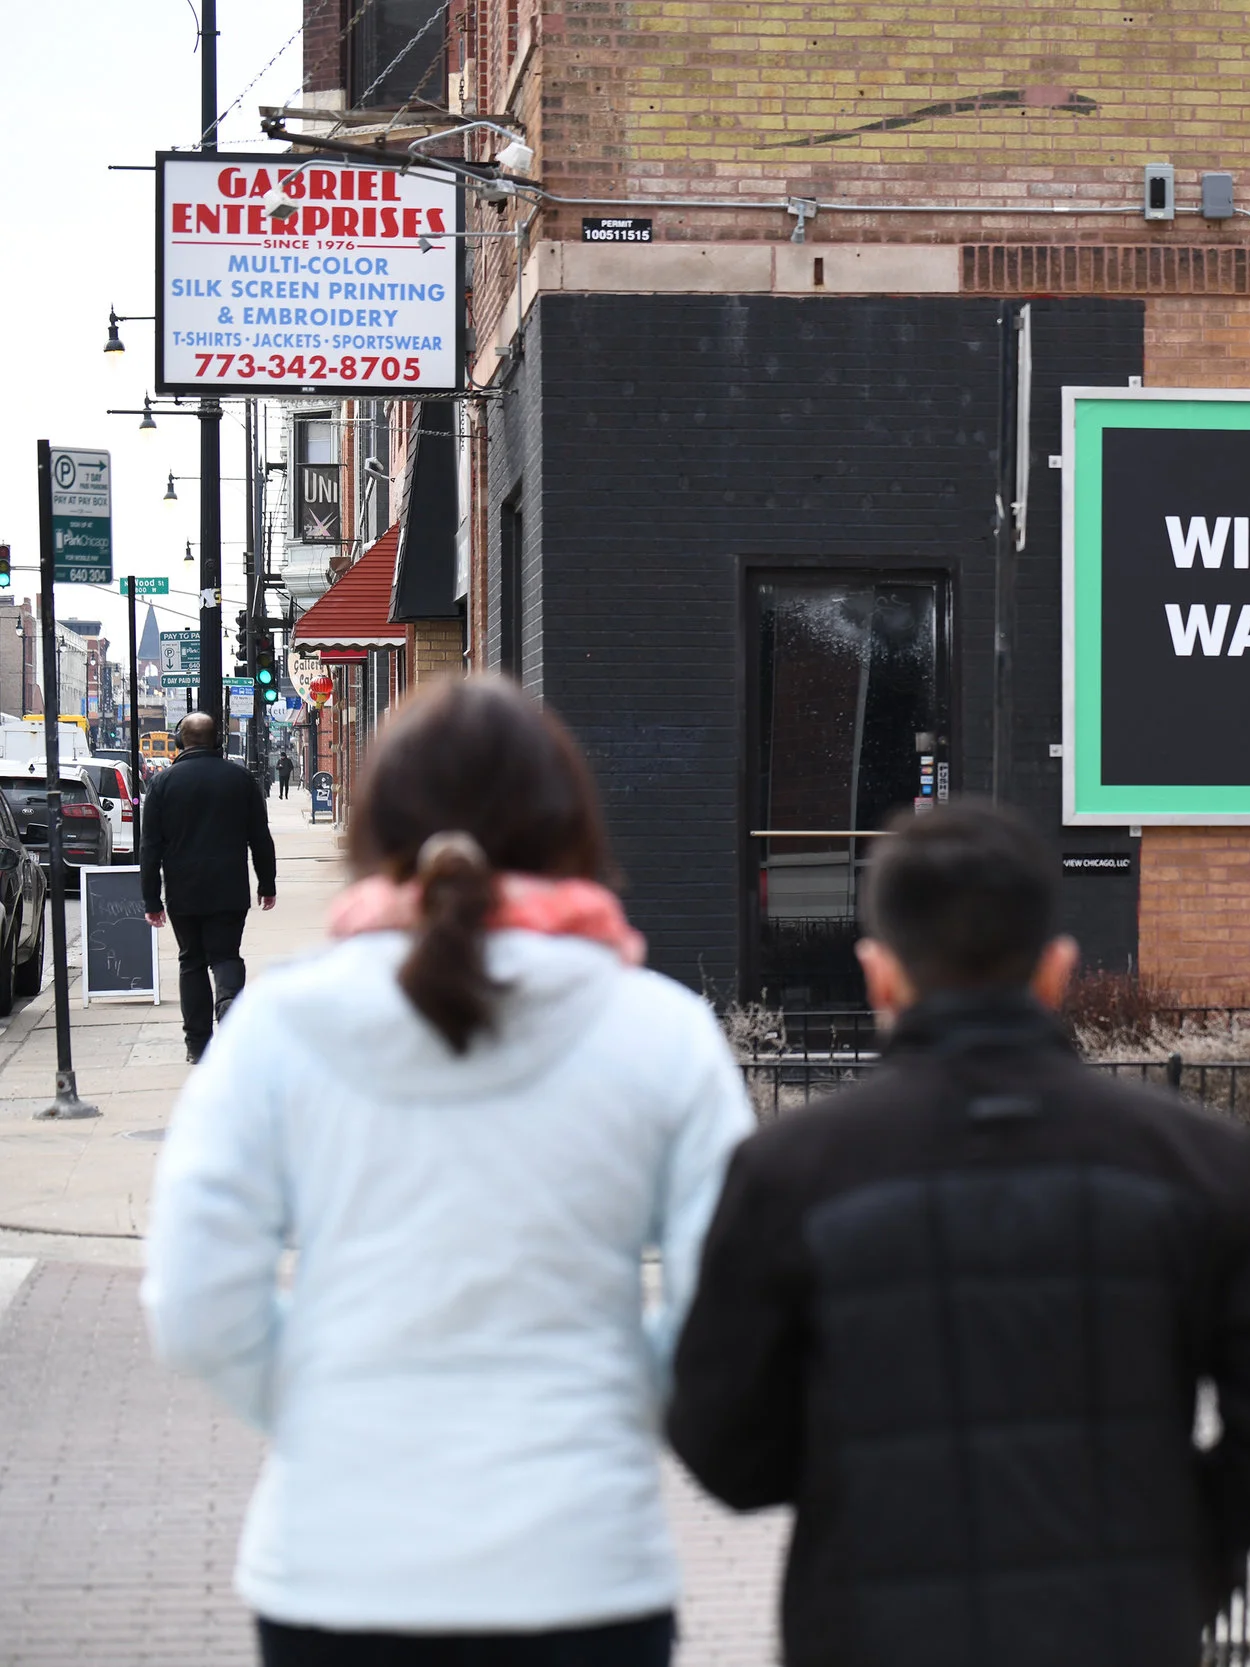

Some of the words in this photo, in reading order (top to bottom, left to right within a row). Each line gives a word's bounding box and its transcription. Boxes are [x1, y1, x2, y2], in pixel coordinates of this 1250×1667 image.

[218, 167, 402, 201] GABRIEL
[172, 203, 446, 239] ENTERPRISES
[601, 220, 632, 228] PERMIT
[264, 238, 309, 250] SINCE
[316, 240, 355, 251] 1976
[585, 229, 650, 241] 100511515
[228, 255, 389, 276] MULTI-COLOR
[171, 278, 222, 298] SILK
[231, 280, 320, 300] SCREEN
[329, 282, 446, 302] PRINTING
[217, 306, 234, 325] &
[243, 307, 399, 328] EMBROIDERY
[173, 331, 242, 347] T-SHIRTS
[252, 333, 322, 349] JACKETS
[332, 335, 443, 351] SPORTSWEAR
[195, 353, 421, 381] 773-342-8705
[69, 568, 88, 582] 640
[88, 569, 107, 582] 304
[179, 632, 190, 640] TO
